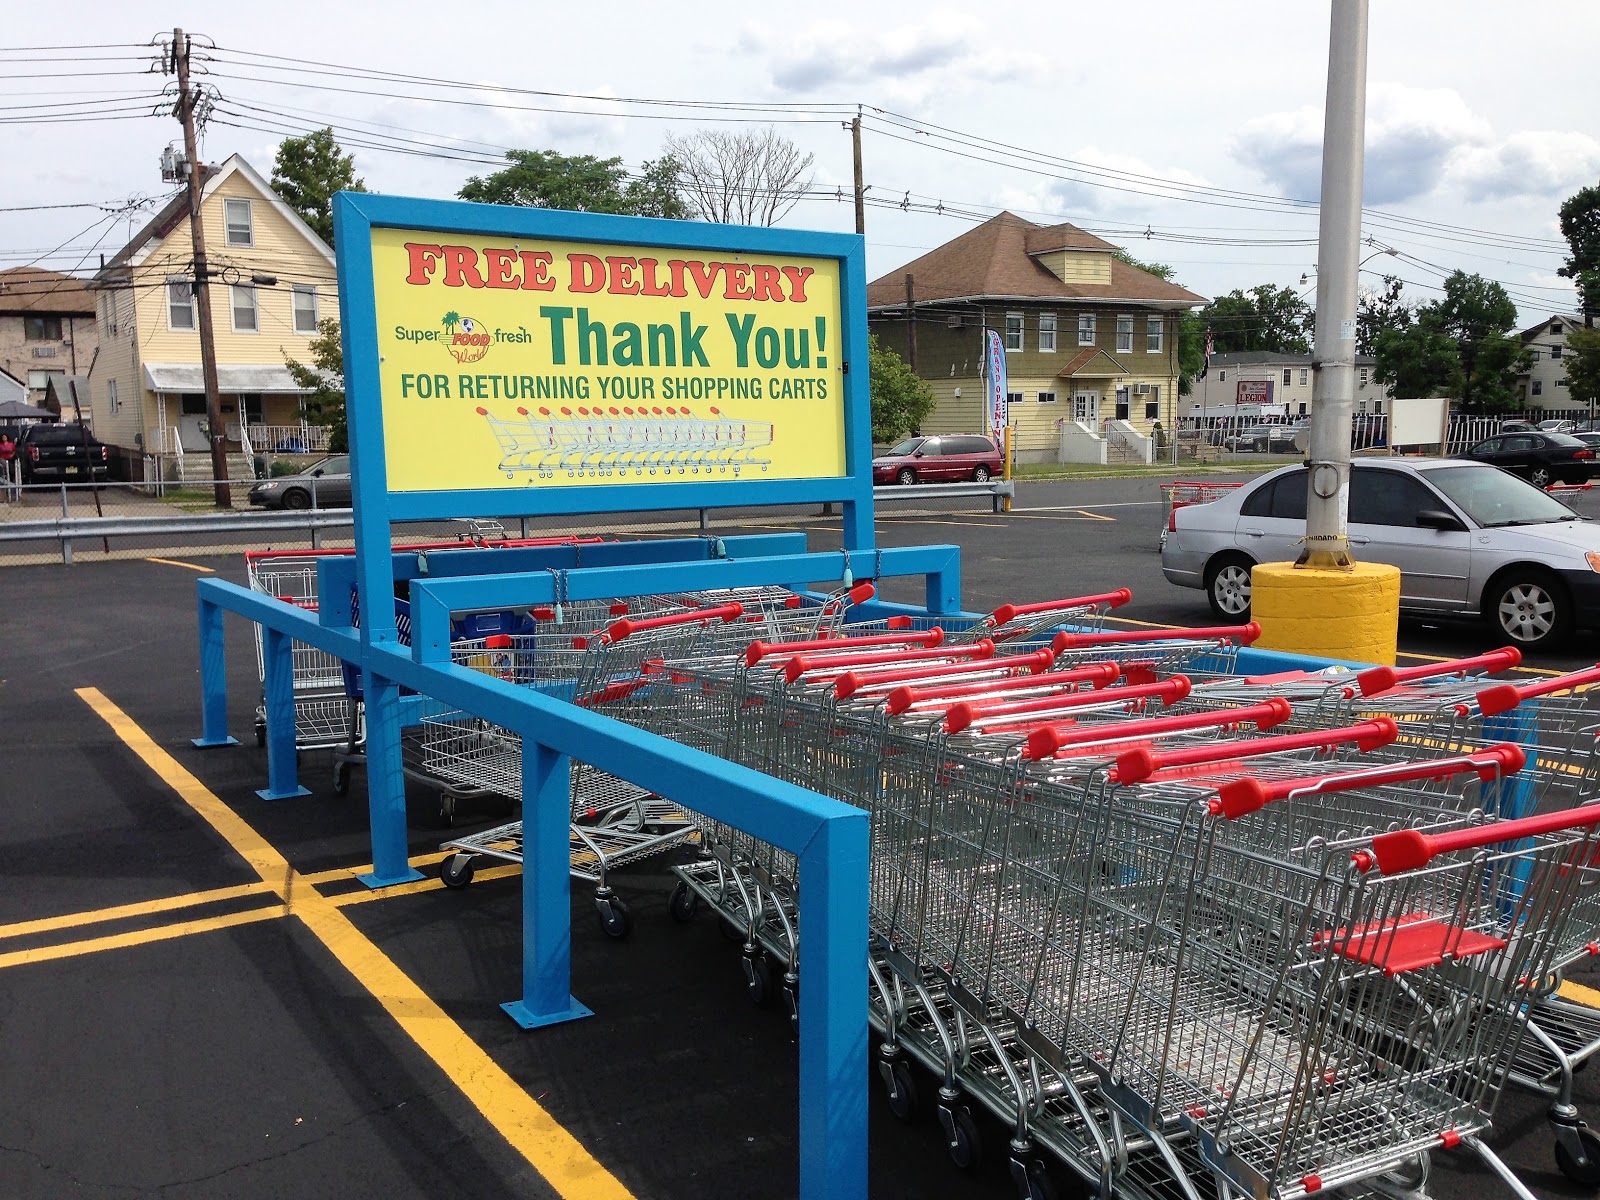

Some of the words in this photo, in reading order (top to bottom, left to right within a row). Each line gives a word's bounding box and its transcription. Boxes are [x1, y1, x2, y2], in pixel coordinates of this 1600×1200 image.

[404, 242, 557, 292] FREE
[566, 253, 815, 303] DELIVERY
[395, 326, 440, 344] Super
[452, 333, 490, 346] FOOD
[494, 326, 532, 343] fresh
[540, 306, 710, 368] Thank
[724, 313, 828, 369] You!
[450, 346, 487, 364] World
[993, 338, 1001, 383] GRAND
[401, 373, 451, 399] FOR
[458, 374, 590, 399] RETURNING
[596, 376, 655, 399] YOUR
[662, 376, 762, 400] SHOPPING
[769, 378, 828, 400] CARTS
[1240, 394, 1267, 402] LEGION
